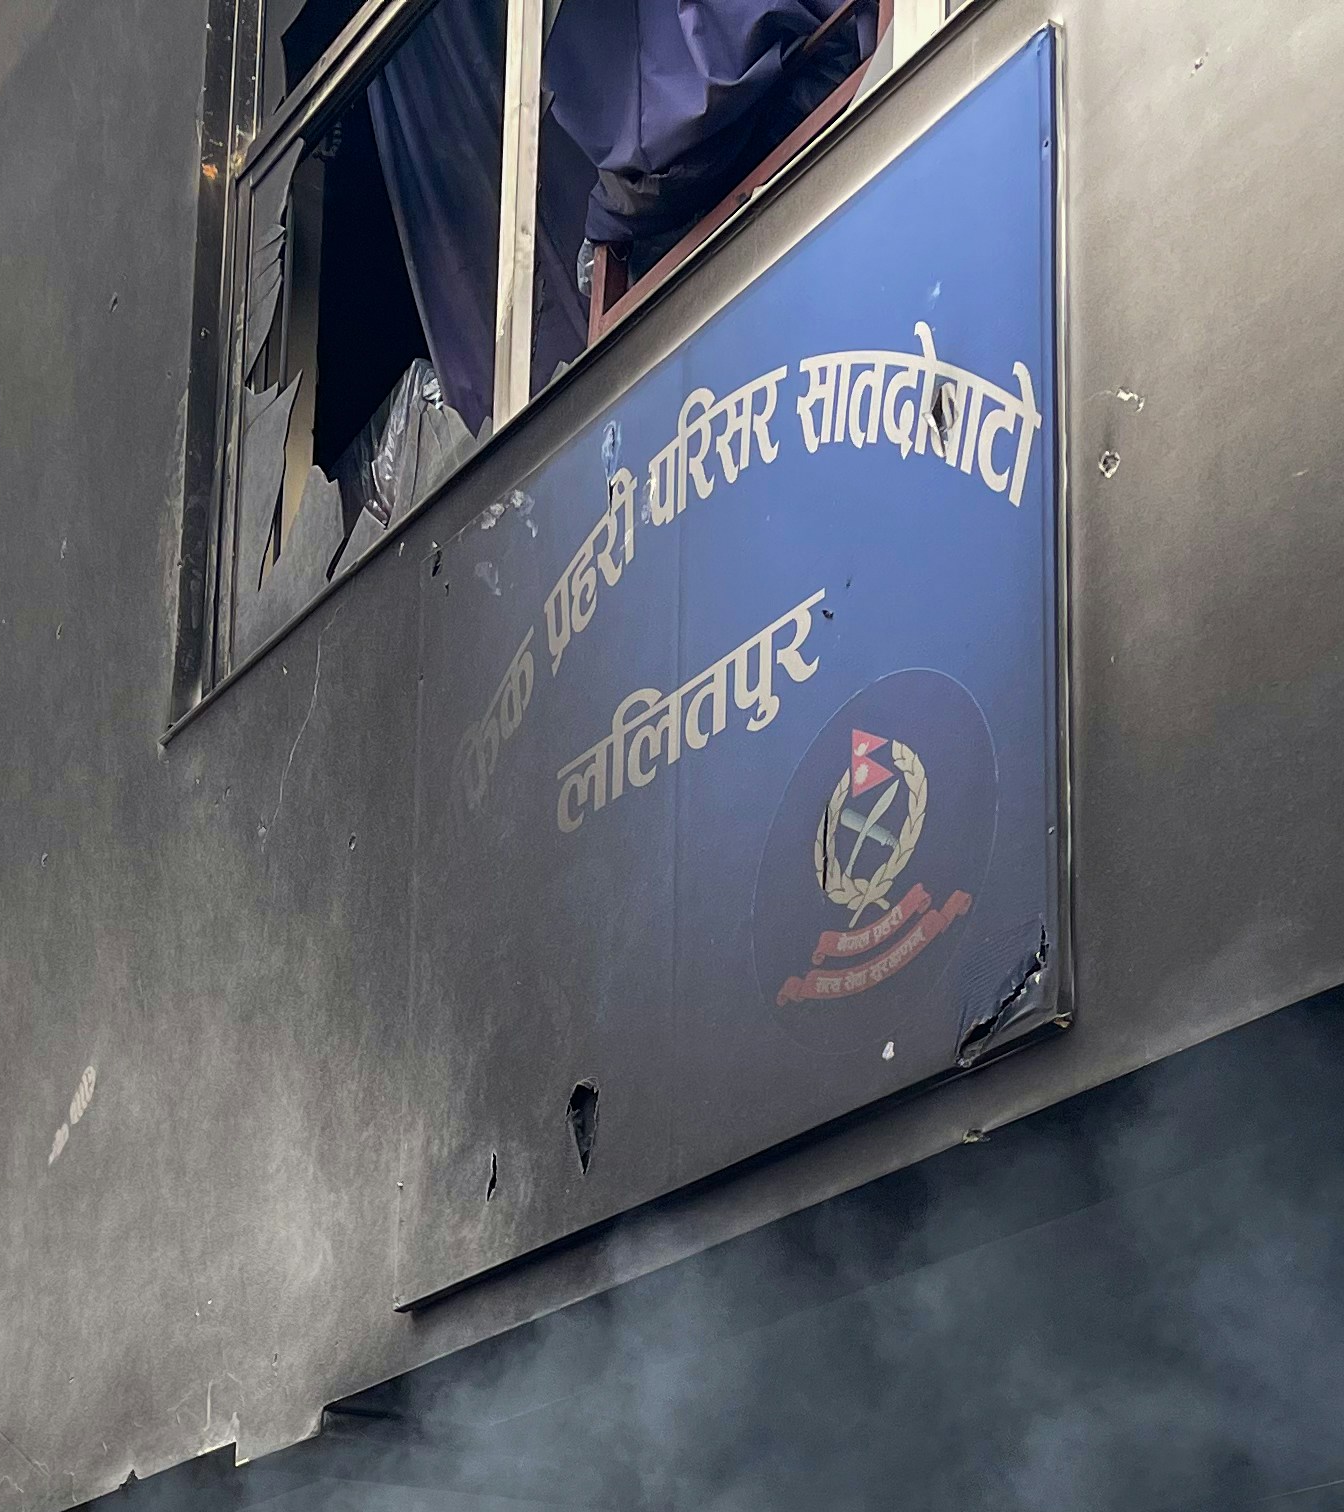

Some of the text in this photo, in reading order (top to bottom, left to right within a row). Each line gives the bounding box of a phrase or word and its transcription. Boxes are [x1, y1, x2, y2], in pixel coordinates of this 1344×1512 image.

[544, 467, 638, 678] प्रहरी
[648, 365, 788, 527] परिसर
[796, 320, 1043, 508] सातदोबाटो
[557, 588, 828, 834] ललितपुर
